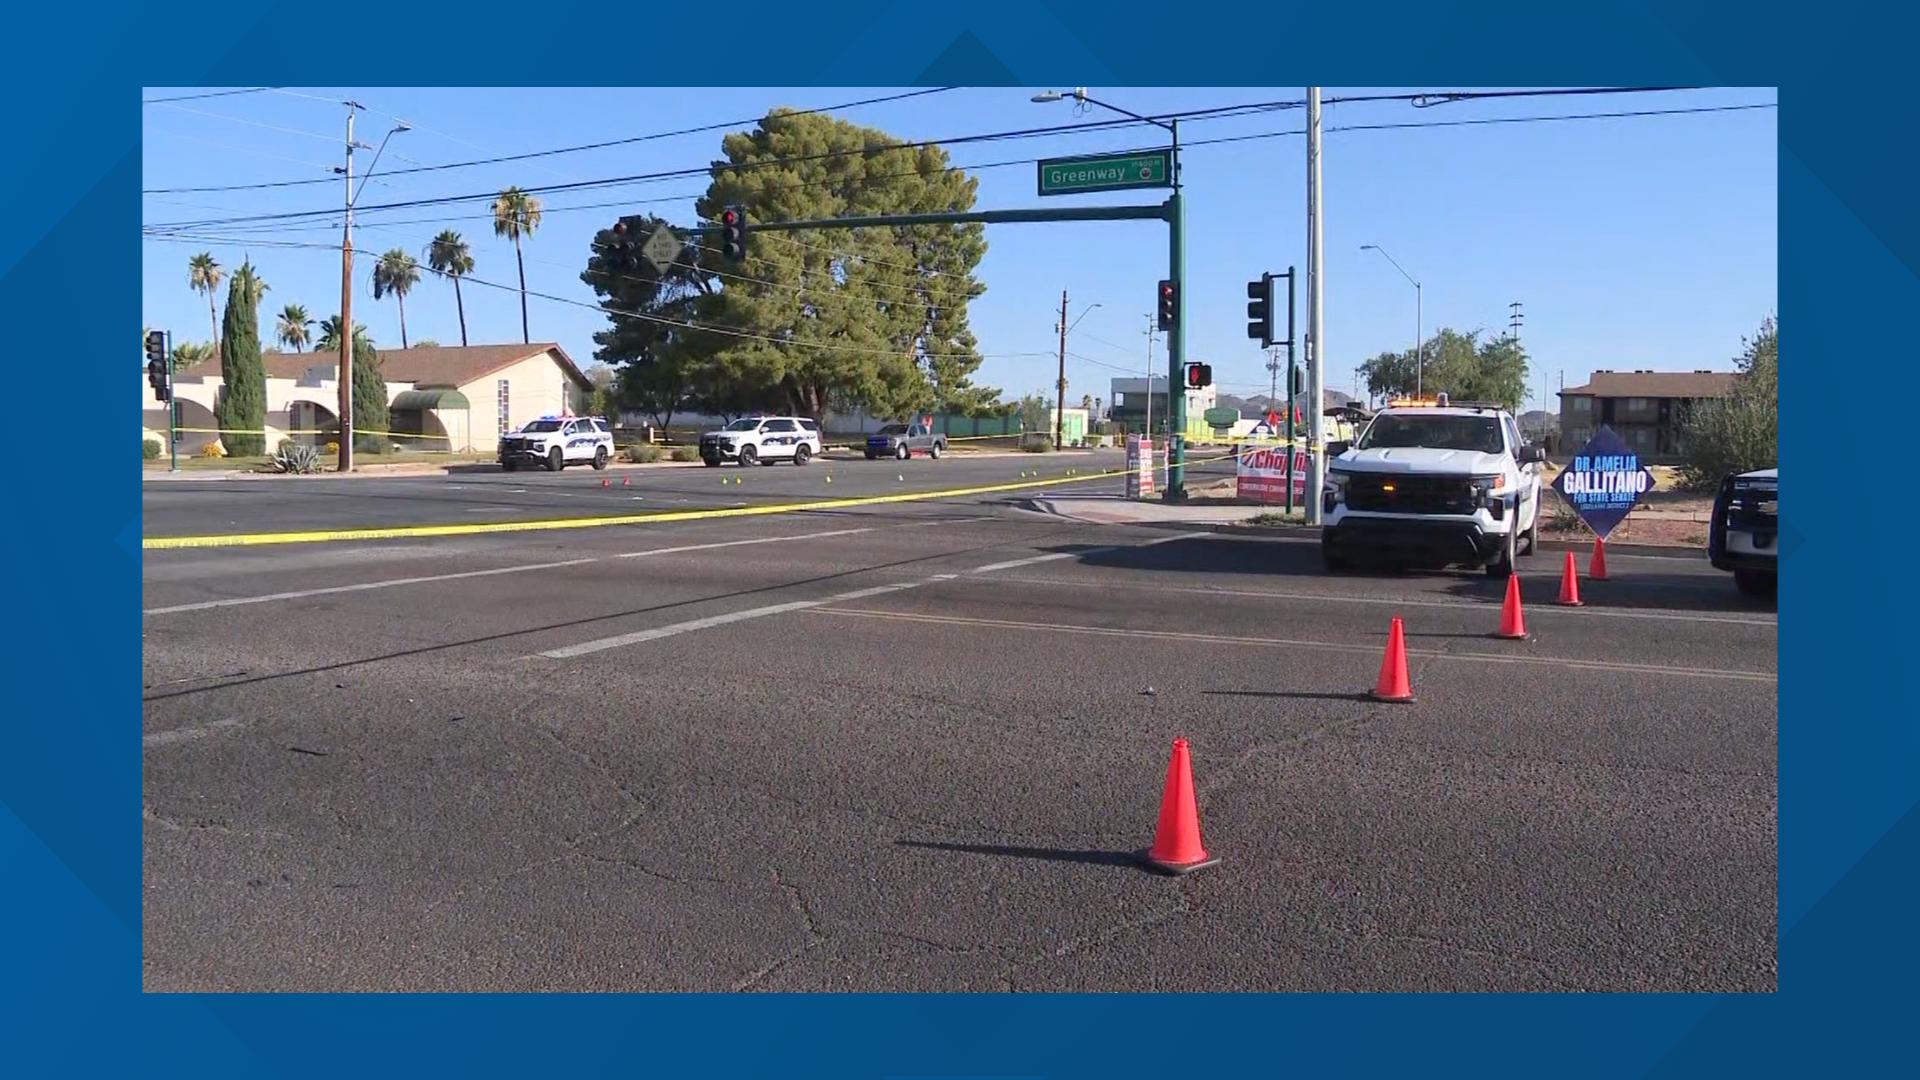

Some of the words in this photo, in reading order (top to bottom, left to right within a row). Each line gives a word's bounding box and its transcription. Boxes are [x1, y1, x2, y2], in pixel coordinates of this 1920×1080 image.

[1051, 167, 1125, 184] Greenway
[1254, 450, 1306, 476] Chapli
[1594, 455, 1637, 471] AMELIA
[1563, 470, 1647, 494] GALLITANO
[1574, 492, 1588, 503] FOR
[1589, 492, 1609, 502] STATE
[1611, 492, 1635, 502] SENATE
